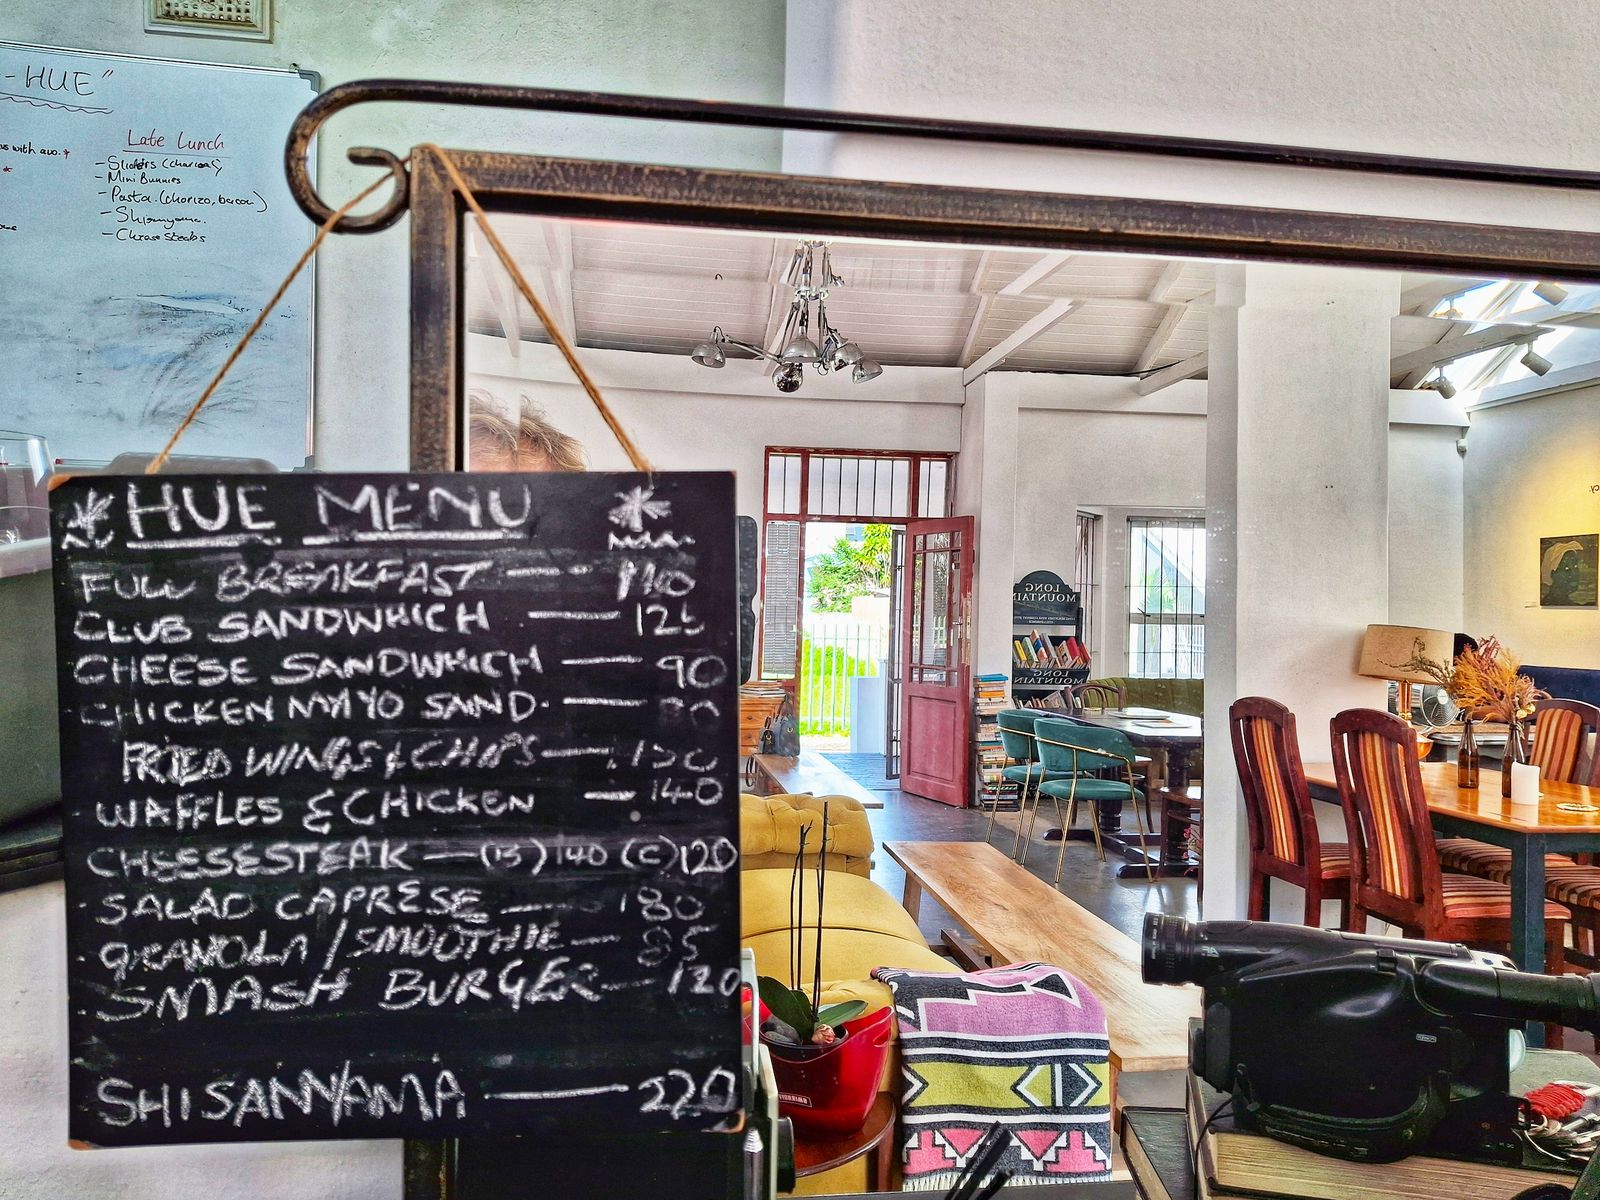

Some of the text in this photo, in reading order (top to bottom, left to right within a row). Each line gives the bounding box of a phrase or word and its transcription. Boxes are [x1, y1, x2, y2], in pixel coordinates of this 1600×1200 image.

[12, 141, 36, 154] with
[128, 128, 225, 150] Late Lunch
[107, 170, 182, 184] Mini Bunnies
[126, 480, 531, 539] HUE MENU
[81, 573, 197, 603] FULL
[216, 560, 494, 602] BREAKFAST
[74, 611, 193, 643] CLUB
[74, 653, 258, 686] CHEESE
[656, 654, 728, 689] 90
[80, 696, 274, 728] CHICKEN
[287, 686, 404, 720] MAYO
[244, 737, 383, 780] WINGS
[95, 790, 284, 832] WAFFLES
[650, 777, 723, 805] 140
[680, 836, 738, 876] 120
[96, 887, 258, 925] SALAD
[275, 879, 490, 924] CAPRESE
[96, 956, 740, 1022] SMASH BURGER 120
[638, 1065, 736, 1121] 220
